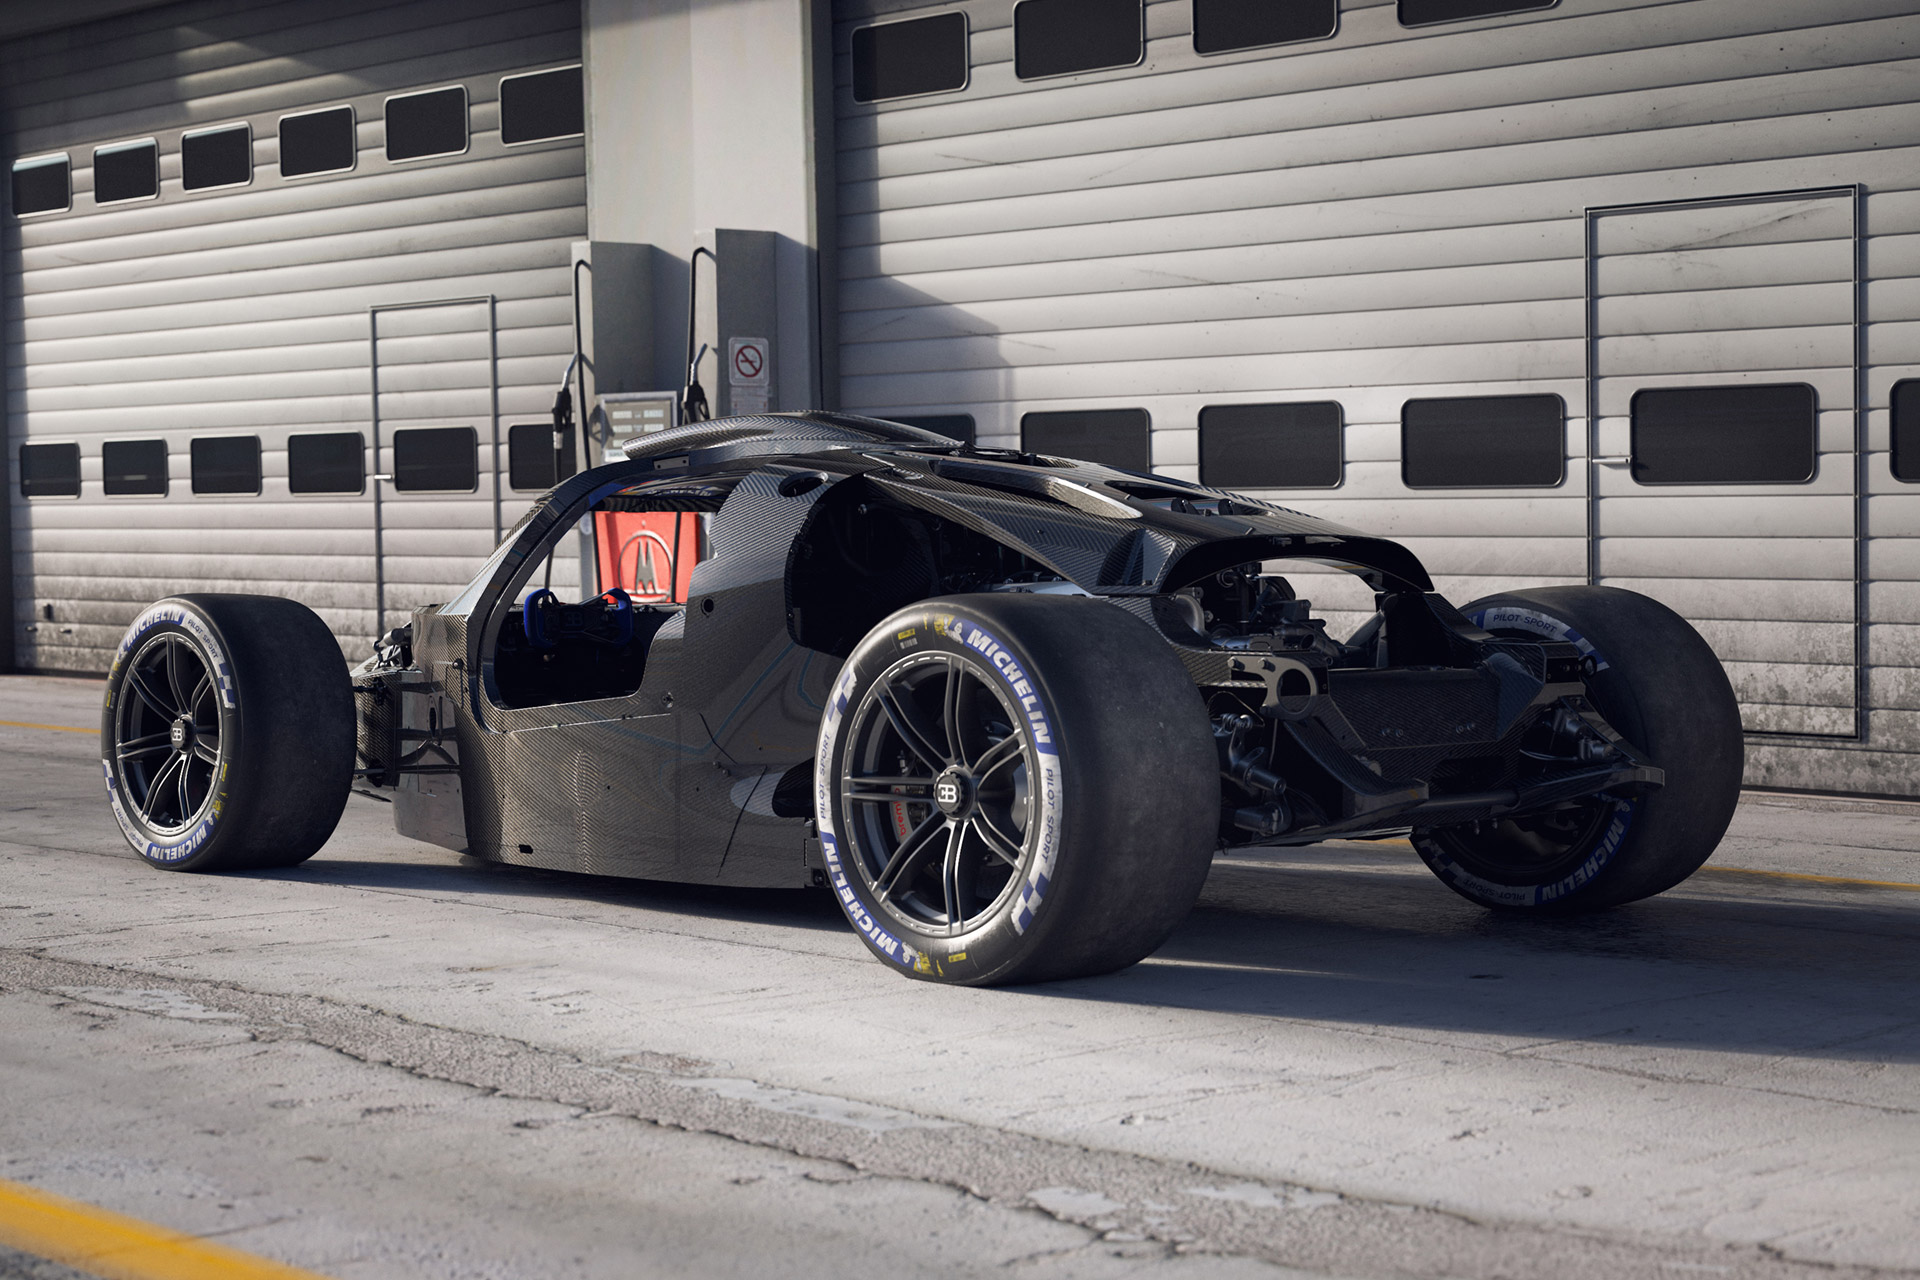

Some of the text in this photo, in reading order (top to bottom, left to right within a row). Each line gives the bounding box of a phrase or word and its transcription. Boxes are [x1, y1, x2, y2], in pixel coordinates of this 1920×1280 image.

[125, 609, 182, 647] MICHELIN
[187, 617, 219, 658] PILOT SPORT
[1493, 613, 1522, 622] PILOT
[1523, 615, 1558, 633] SPORT
[966, 628, 1052, 744] MICHELIN
[818, 732, 831, 820] PILOT SPORT
[150, 823, 207, 860] MICHELIN
[1041, 767, 1056, 864] PILOT SPORT
[1462, 879, 1526, 901] PILOT SPORT
[1542, 817, 1625, 901] MICHELIN
[823, 841, 899, 956] MICHELIN
